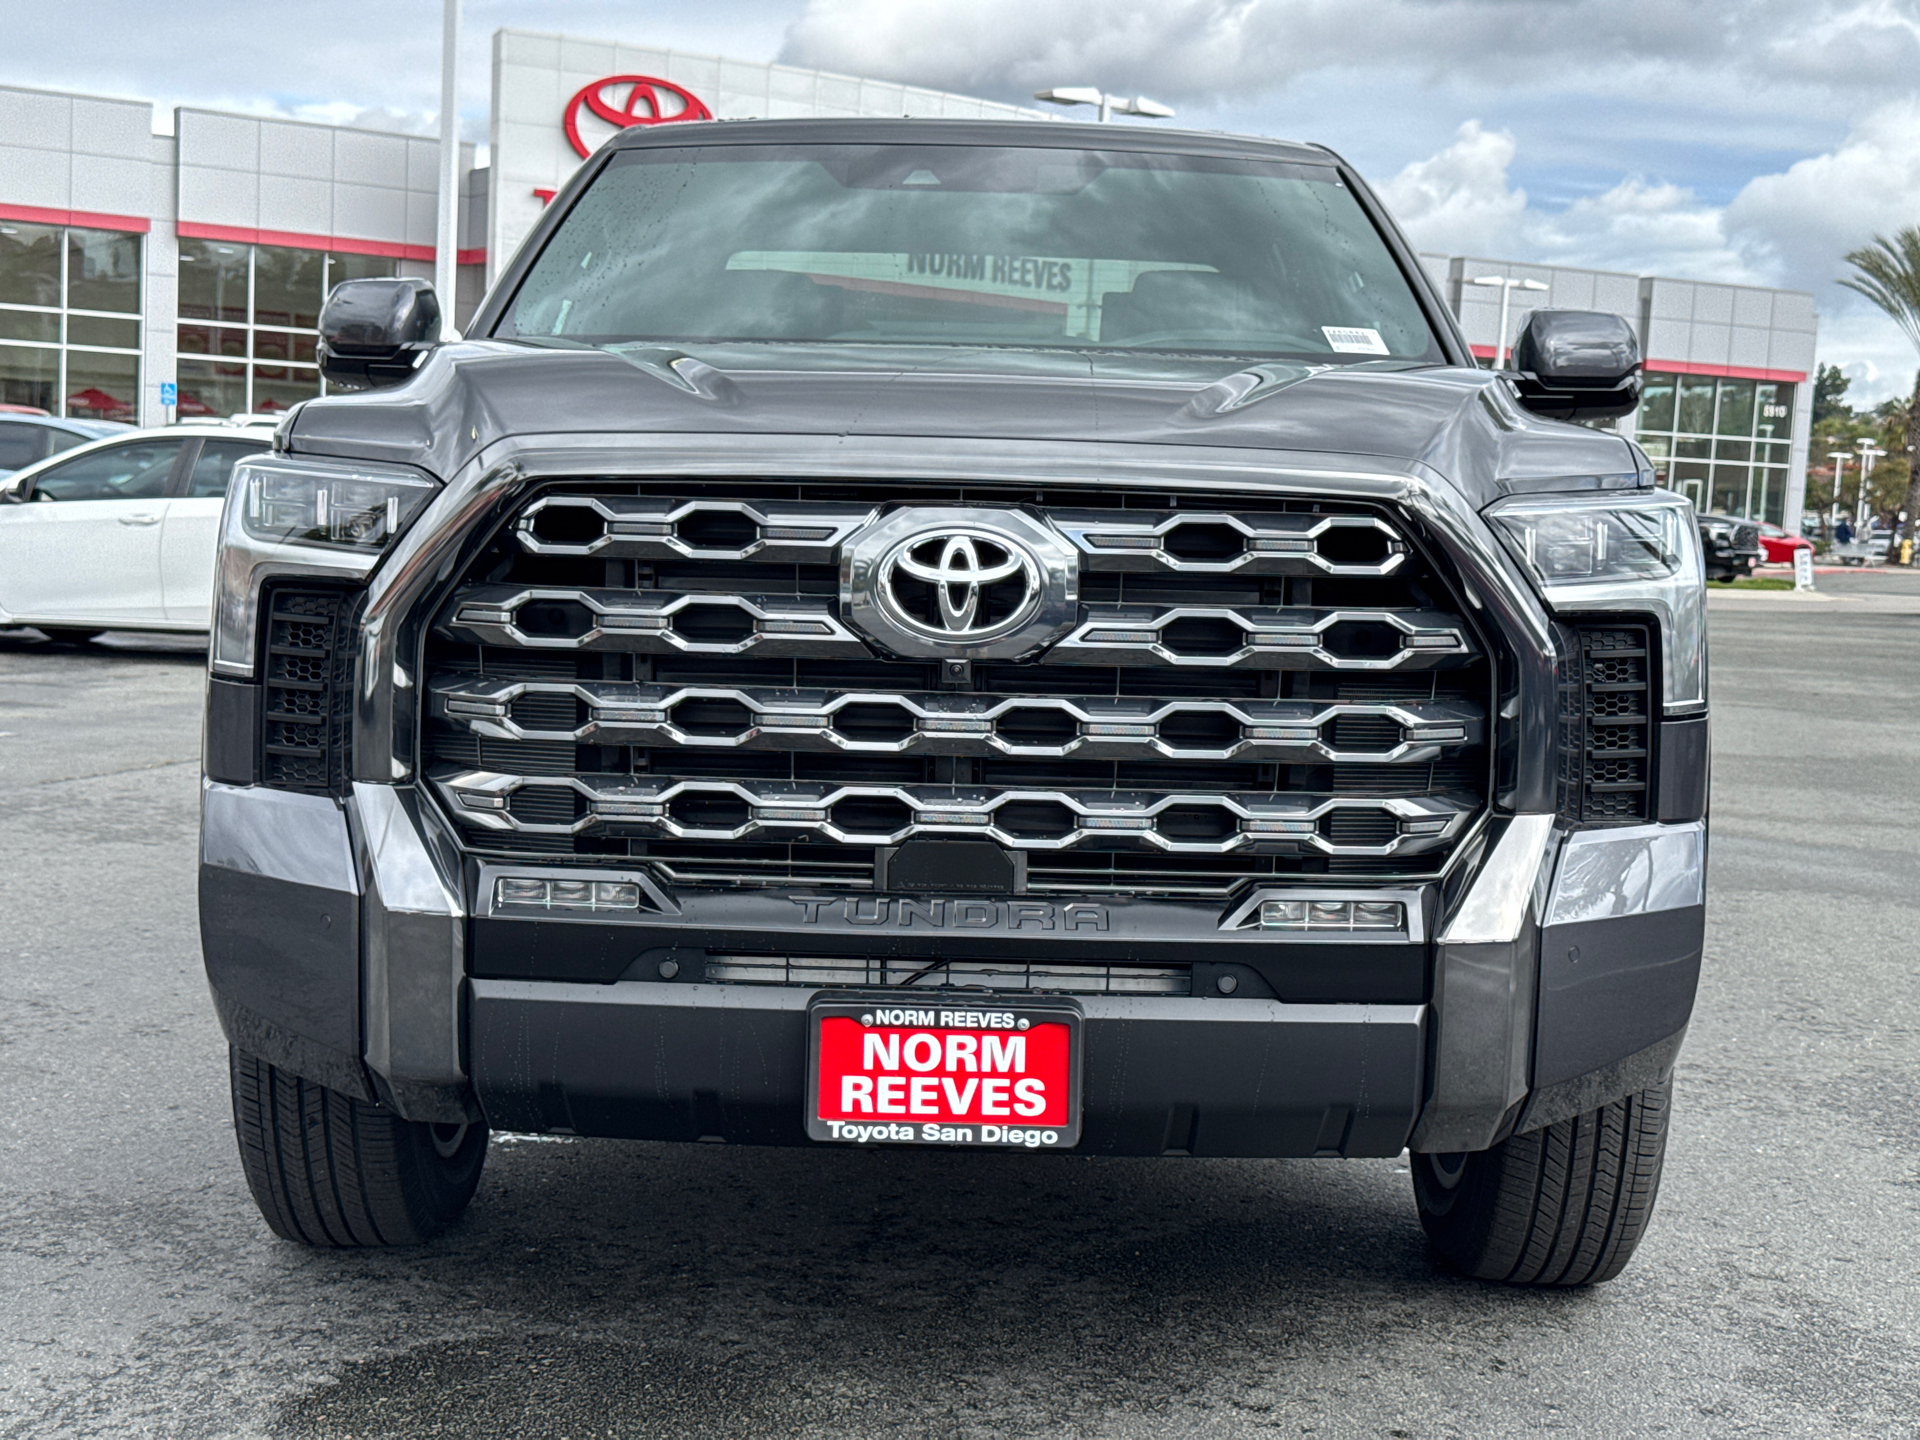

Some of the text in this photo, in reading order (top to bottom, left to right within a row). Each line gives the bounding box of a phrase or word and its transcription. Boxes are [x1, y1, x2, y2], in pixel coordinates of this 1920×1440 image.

[992, 255, 1072, 292] REEVES
[788, 895, 1110, 931] TUNDRA
[876, 1009, 1015, 1029] NORM REEVES
[863, 1033, 1026, 1073] NORM
[841, 1075, 1047, 1117] REEVES
[827, 1121, 1059, 1148] Toyota San Diego
